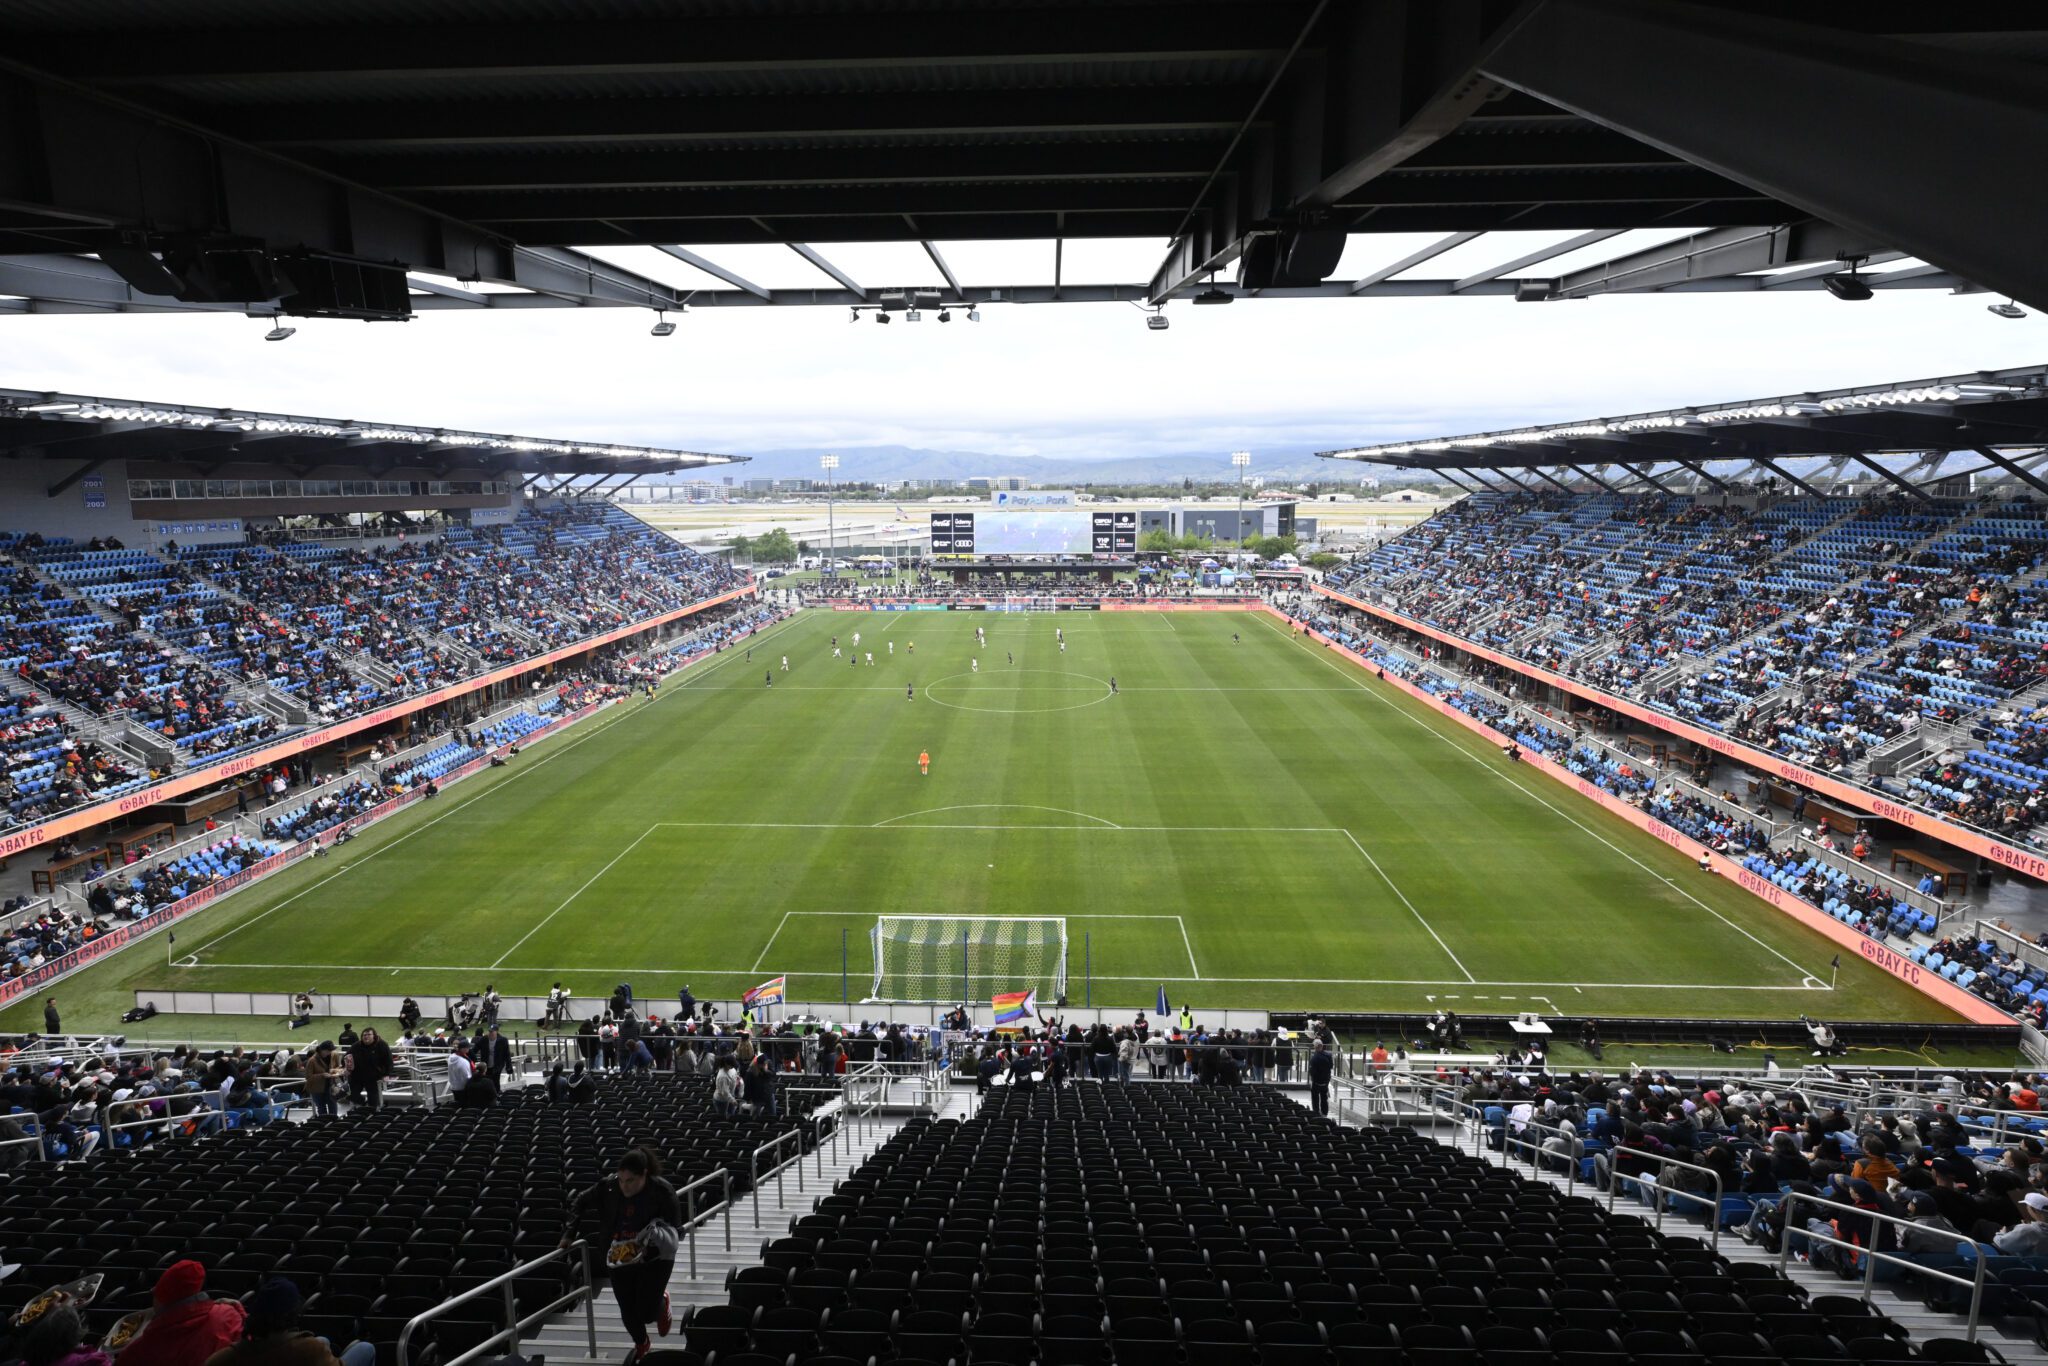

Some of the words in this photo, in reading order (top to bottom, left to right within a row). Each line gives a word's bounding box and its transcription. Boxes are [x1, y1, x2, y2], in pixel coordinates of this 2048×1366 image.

[1011, 495, 1043, 505] PayPal
[1046, 495, 1068, 505] Park
[310, 735, 321, 746] BAY
[322, 731, 330, 740] FC
[1715, 738, 1726, 751] BAY
[1727, 743, 1735, 755] FC
[231, 760, 245, 774] BAY
[246, 757, 255, 767] FC
[1790, 767, 1804, 783] BAY
[1805, 774, 1815, 787] FC
[133, 794, 149, 808] BAY
[151, 789, 162, 800] FC
[1884, 803, 1901, 821] BAY
[1902, 810, 1915, 826] FC
[6, 834, 27, 852] BAY
[30, 829, 44, 844] FC
[1656, 822, 1670, 841] BAY
[1671, 831, 1681, 847] FC
[262, 860, 274, 872] BAY
[275, 854, 285, 865] FC
[2005, 850, 2027, 870] BAY
[2030, 859, 2045, 877] FC
[225, 875, 239, 888] BAY
[241, 869, 250, 881] FC
[187, 893, 201, 908] BAY
[202, 887, 213, 900] FC
[1750, 875, 1768, 899] BAY
[1769, 887, 1782, 905] FC
[142, 915, 158, 930] BAY
[160, 908, 172, 921] FC
[93, 937, 112, 954] BAY
[114, 929, 127, 944] FC
[40, 962, 60, 981] BAY
[62, 954, 76, 970] FC
[1877, 947, 1901, 973] BAY
[1903, 962, 1920, 985] FC
[5, 981, 20, 998] FC
